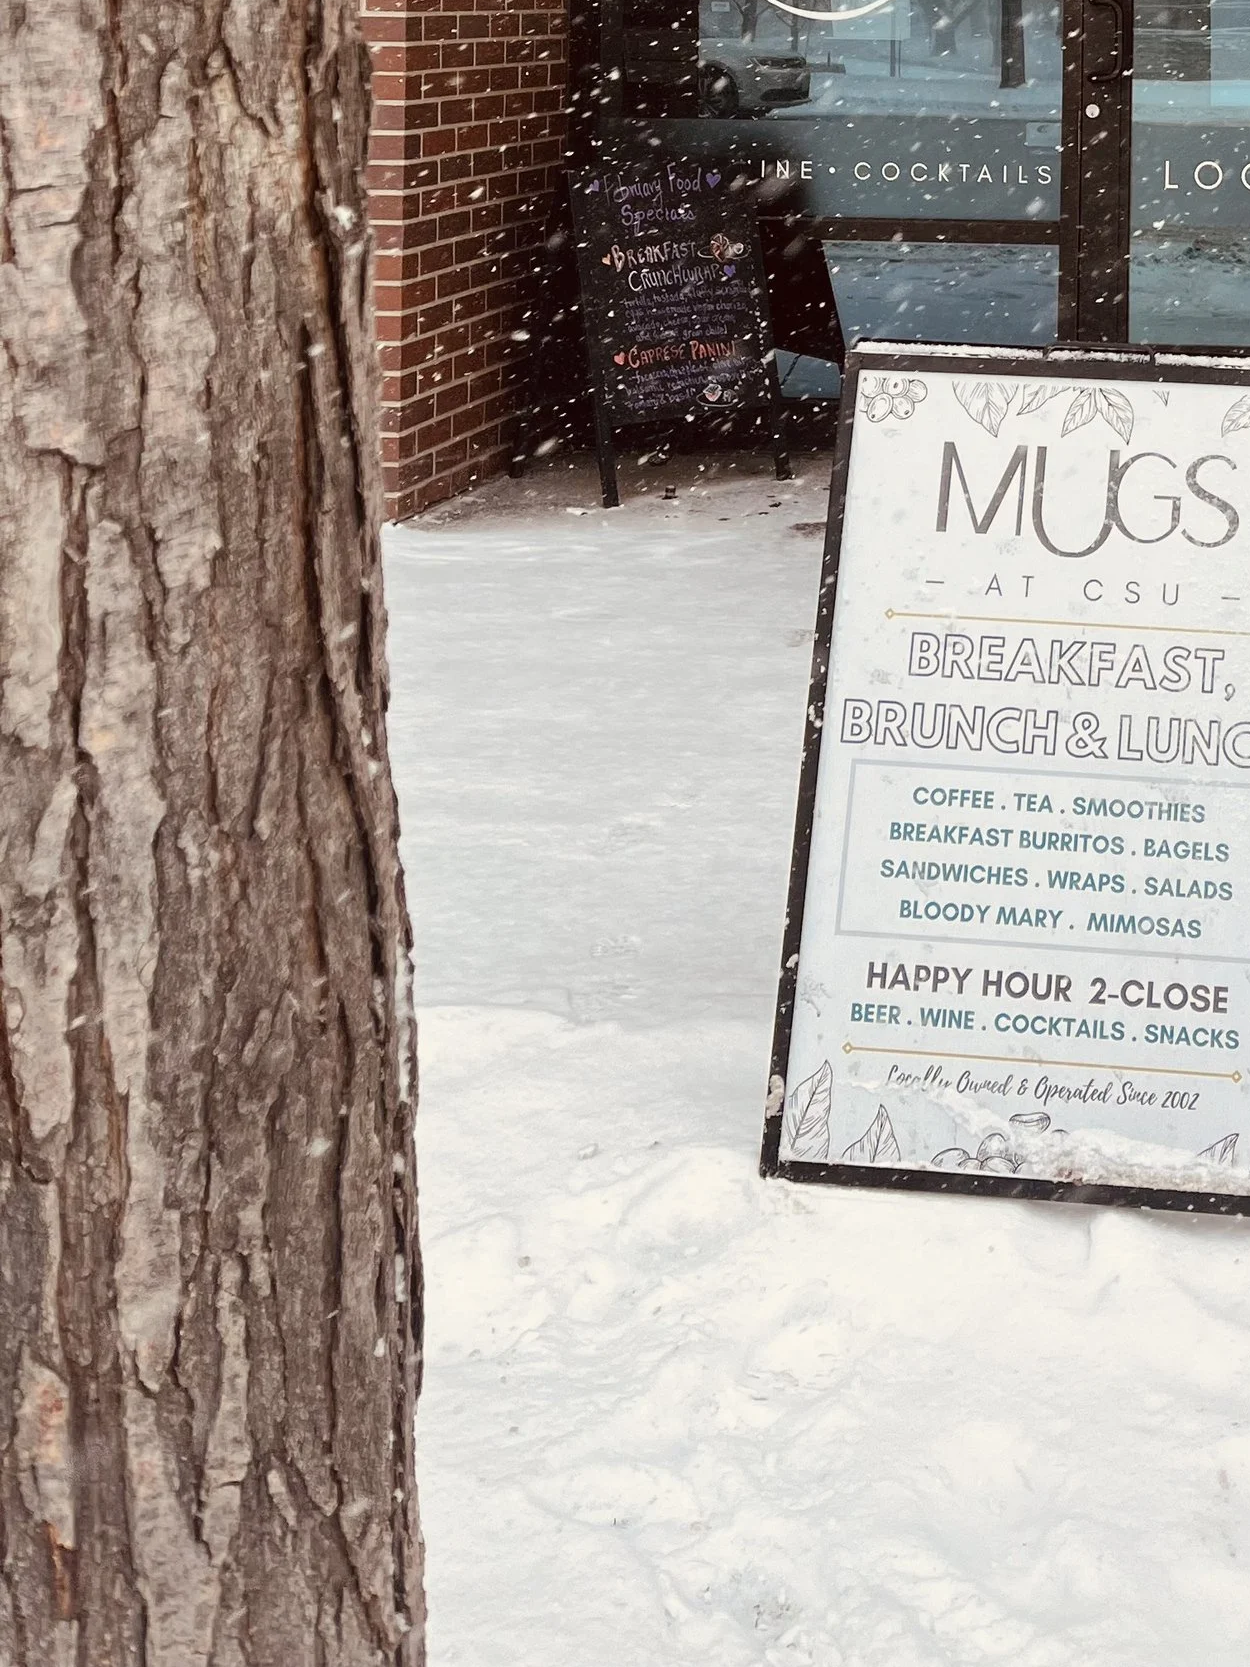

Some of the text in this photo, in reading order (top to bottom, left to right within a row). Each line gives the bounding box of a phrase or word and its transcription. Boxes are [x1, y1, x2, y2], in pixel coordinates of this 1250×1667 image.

[667, 162, 703, 193] Food
[761, 159, 1052, 185] INE COCKTAILS
[610, 240, 697, 272] BREAKFAST
[628, 340, 736, 369] CAPRESE PANINI
[935, 441, 1240, 558] MUGS
[984, 574, 1182, 606] AT CSU
[908, 632, 1236, 701] BREAKFAST,
[912, 786, 1206, 824] COFFEE TEA SMOOTHIES
[888, 822, 1231, 864] BREAKFAST BURRITOS BAGELS
[879, 859, 1234, 902] SANDWICHES WRAPS SALADS
[899, 899, 1203, 939] BLOODY MARY MIMOSAS
[866, 961, 1230, 1014] HAPPY HOUR 2-CLOSE
[850, 1002, 1240, 1051] BEER WINE COCKTAILS SNACKS
[955, 1069, 1014, 1097] Owned
[1016, 1079, 1030, 1096] &
[1034, 1075, 1114, 1107] Operated
[1116, 1080, 1158, 1107] Since
[1160, 1089, 1203, 1112] 2002
